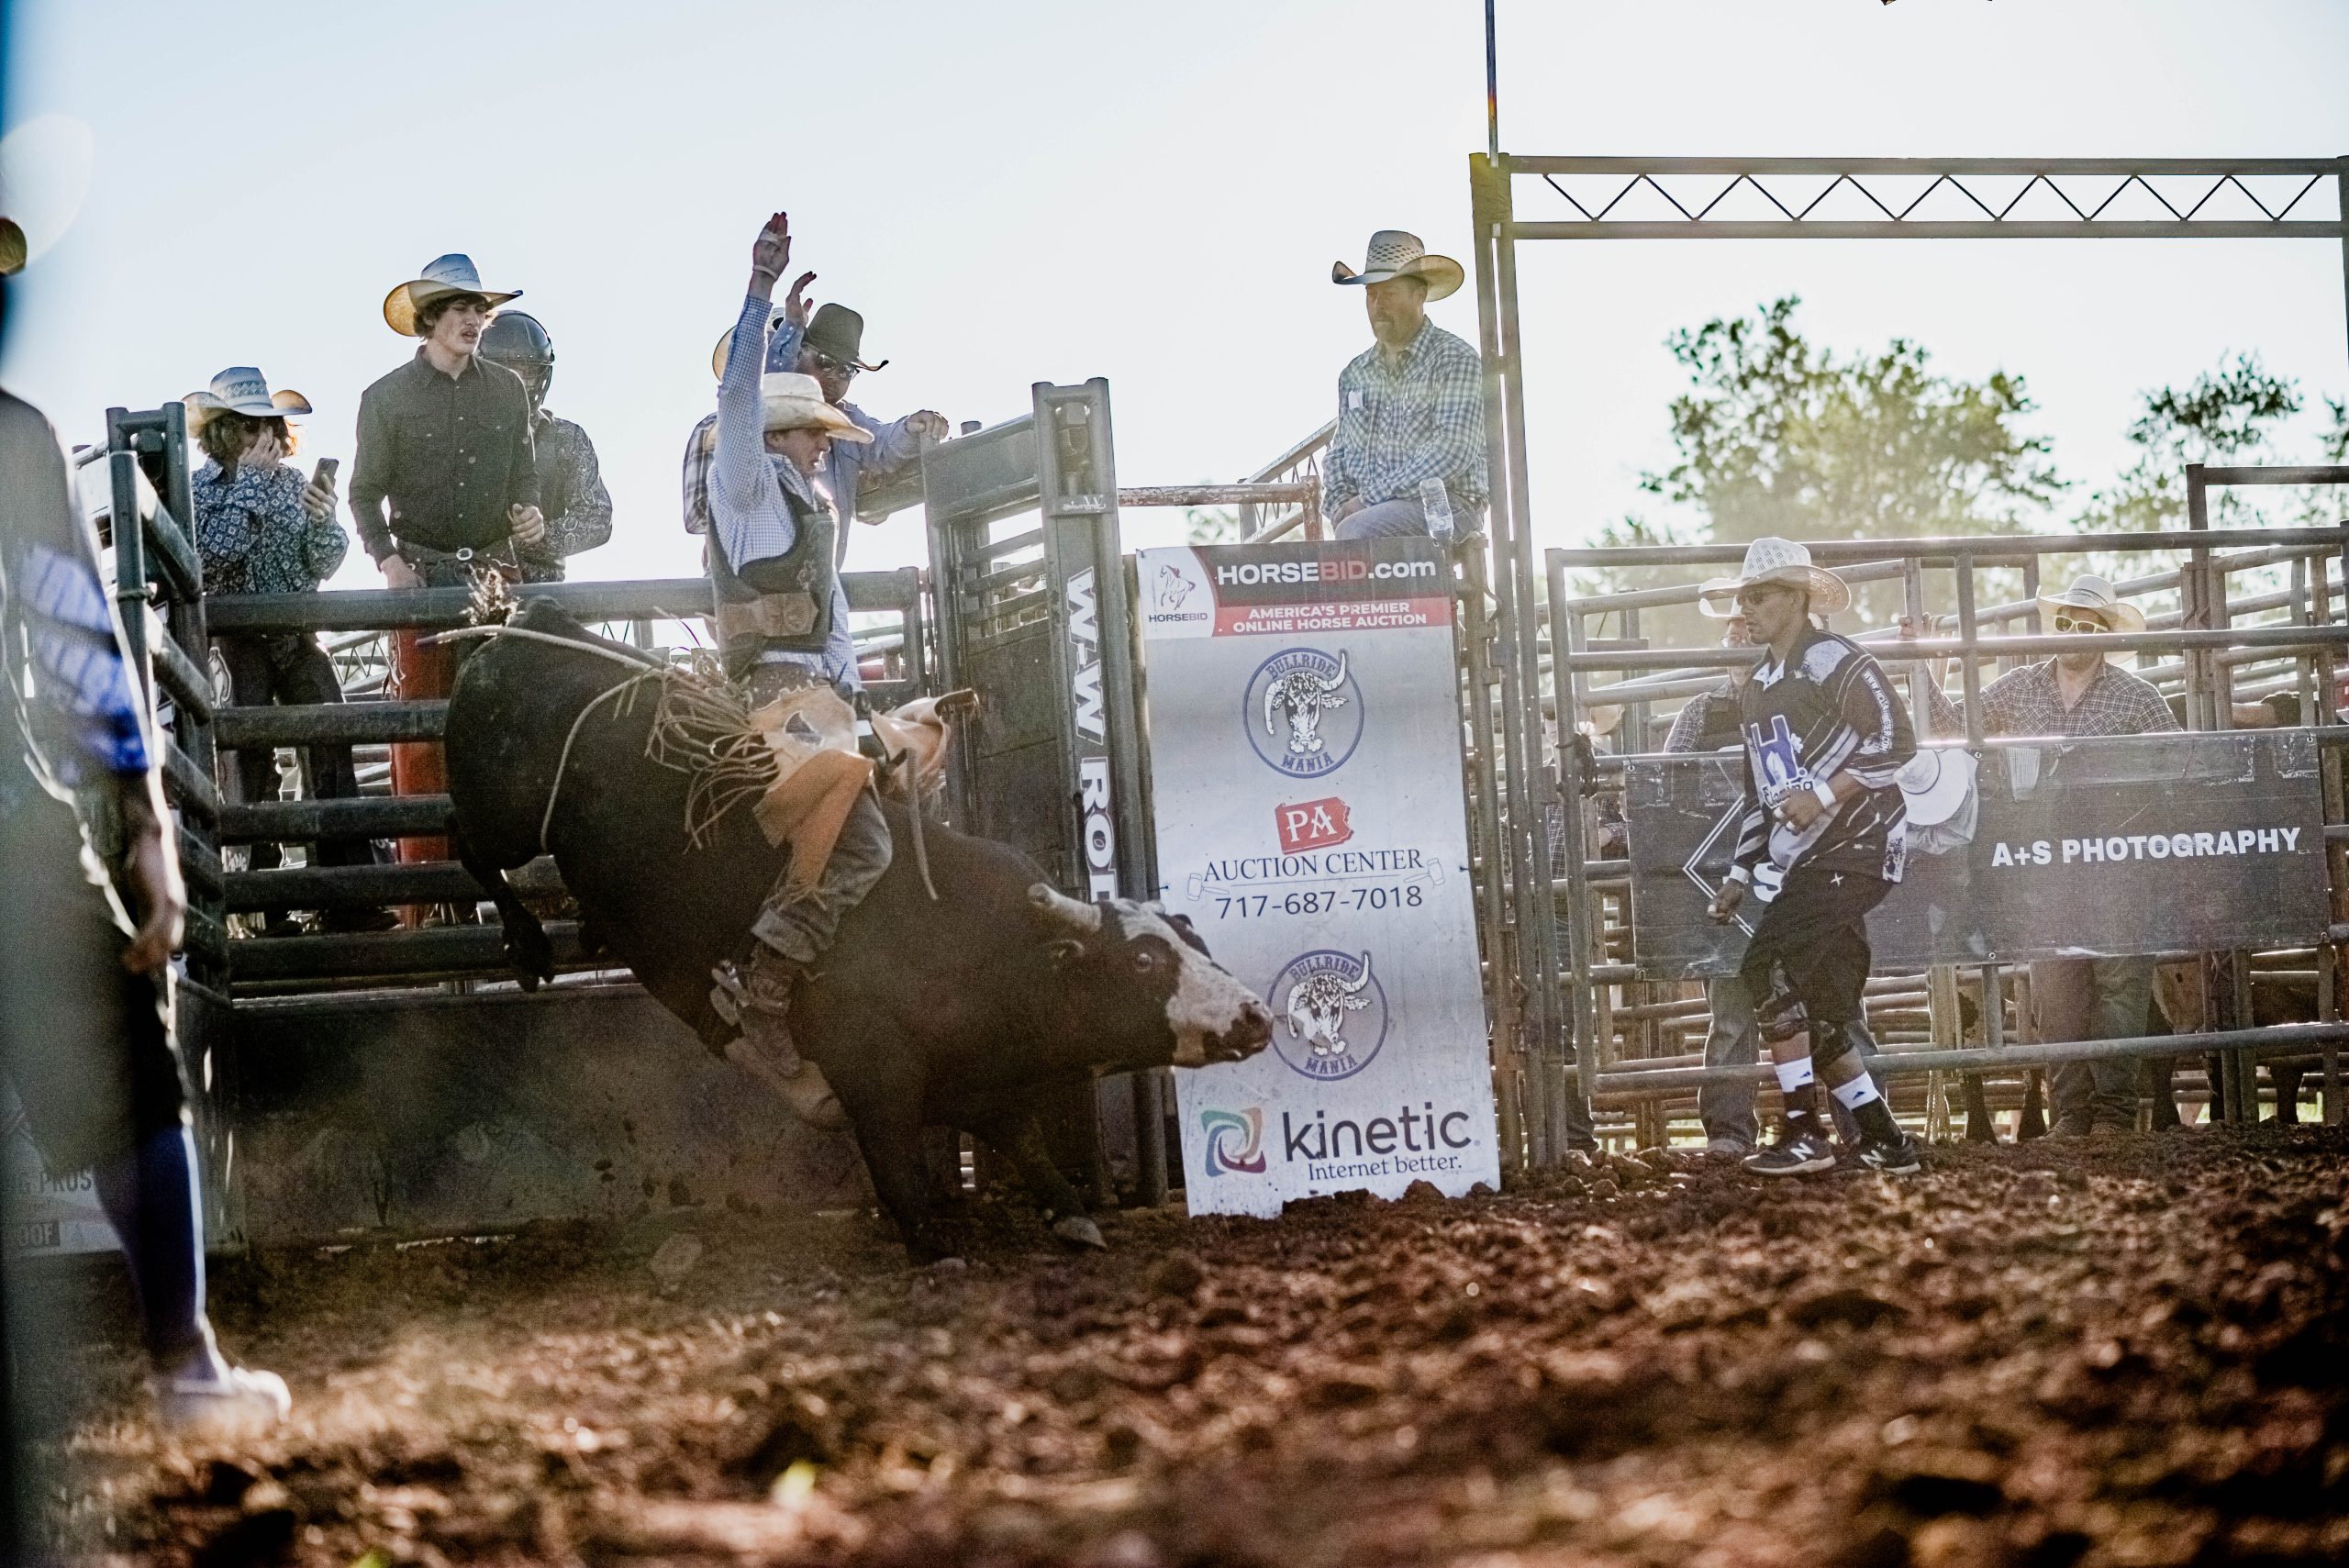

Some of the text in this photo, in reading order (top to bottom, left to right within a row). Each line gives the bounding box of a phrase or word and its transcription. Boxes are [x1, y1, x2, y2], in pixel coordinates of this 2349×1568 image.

[1217, 560, 1436, 585] HORSEBID.com
[1149, 612, 1208, 623] HORSEBID
[1232, 613, 1427, 633] ONLINE HORSE AUCTION
[1248, 602, 1409, 619] AMERICA'S PREMIER
[1265, 653, 1337, 679] BULLRIDE
[1282, 751, 1334, 772] MANIA
[1285, 805, 1337, 843] PA
[1991, 828, 2301, 867] A+S PHOTOGRAPHY
[1204, 849, 1425, 882] AUCTION CENTER
[1215, 885, 1423, 919] 717-687-7018
[1289, 955, 1359, 980] BULLRIDE
[1305, 1053, 1358, 1074] MANIA
[1283, 1101, 1472, 1162] kinetic
[1308, 1152, 1463, 1181] Internet better.
